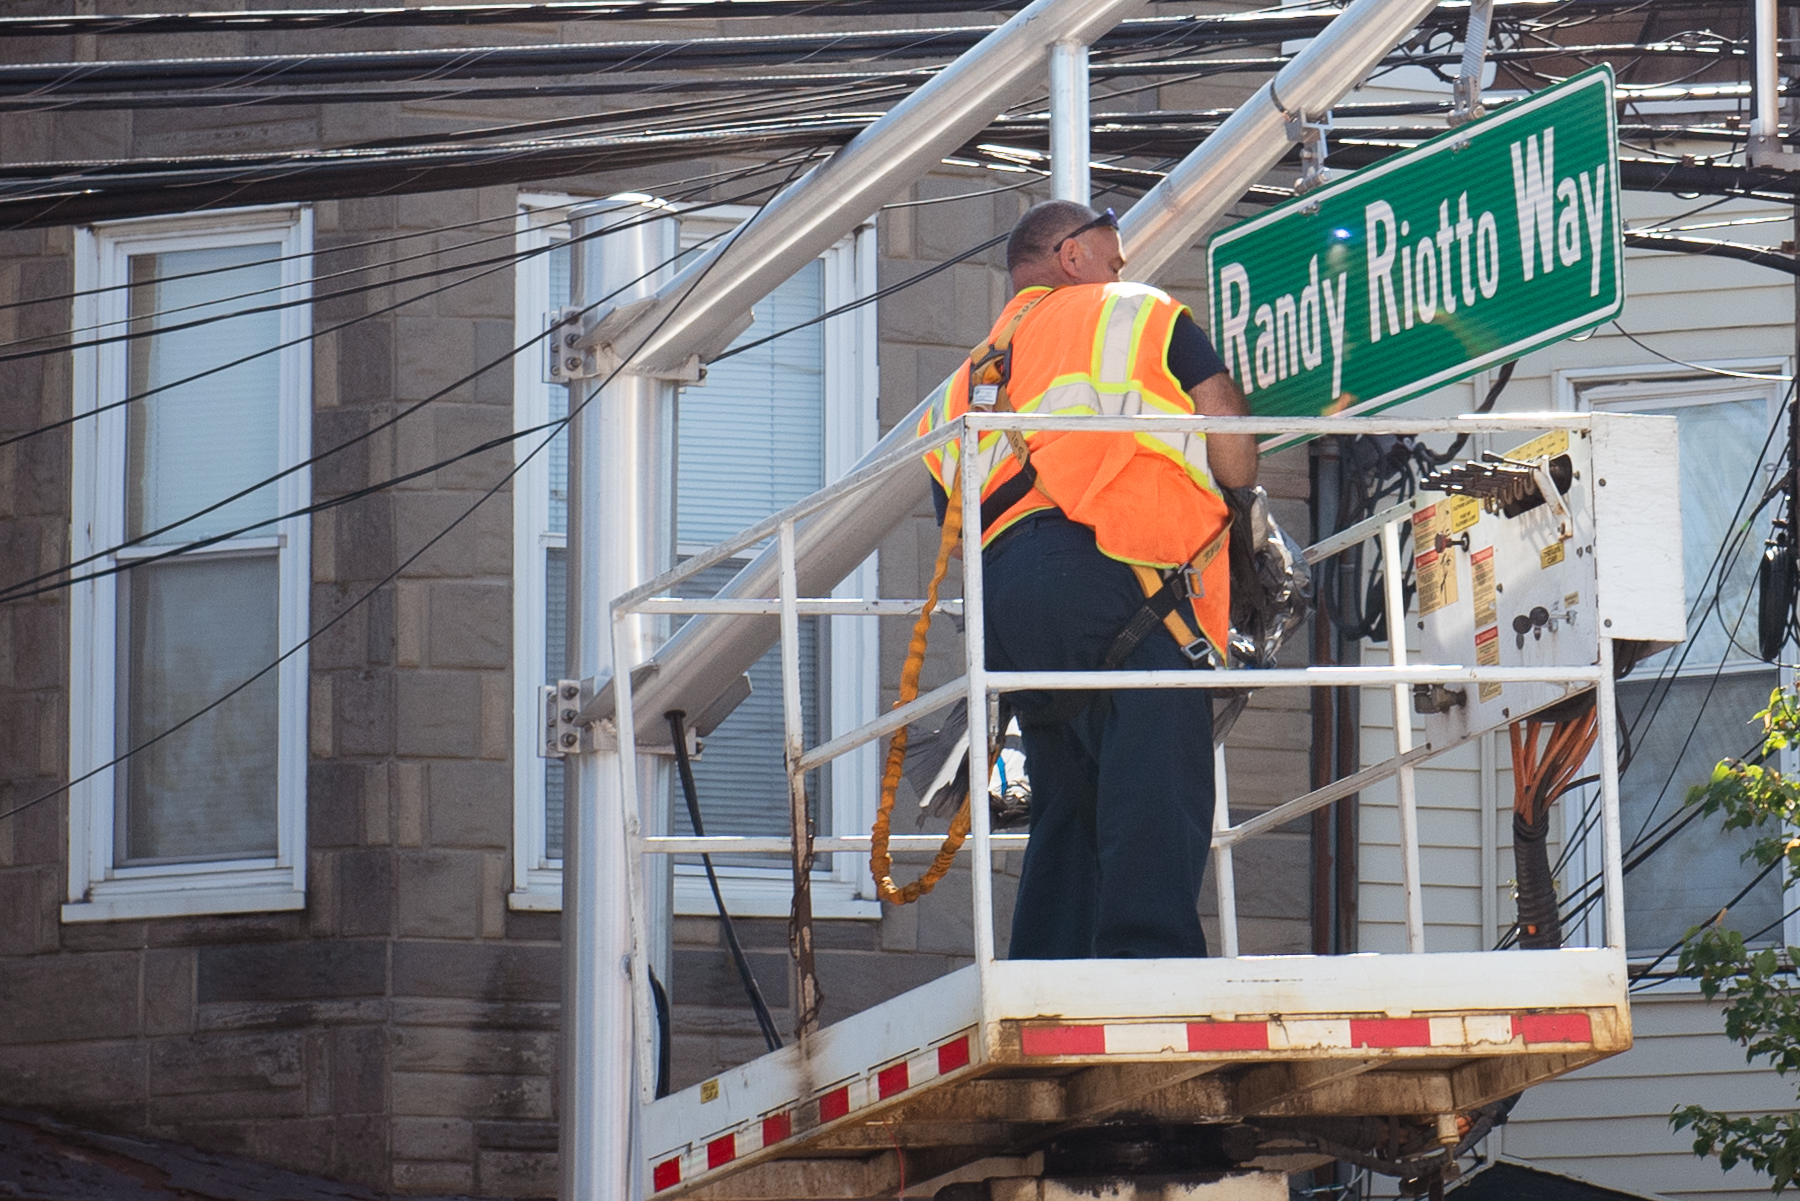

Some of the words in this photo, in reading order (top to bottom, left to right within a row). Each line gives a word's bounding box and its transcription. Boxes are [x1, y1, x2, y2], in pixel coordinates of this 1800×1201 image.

[1221, 254, 1347, 399] Randy
[1365, 190, 1499, 343] Riotto
[1510, 127, 1606, 297] Way
